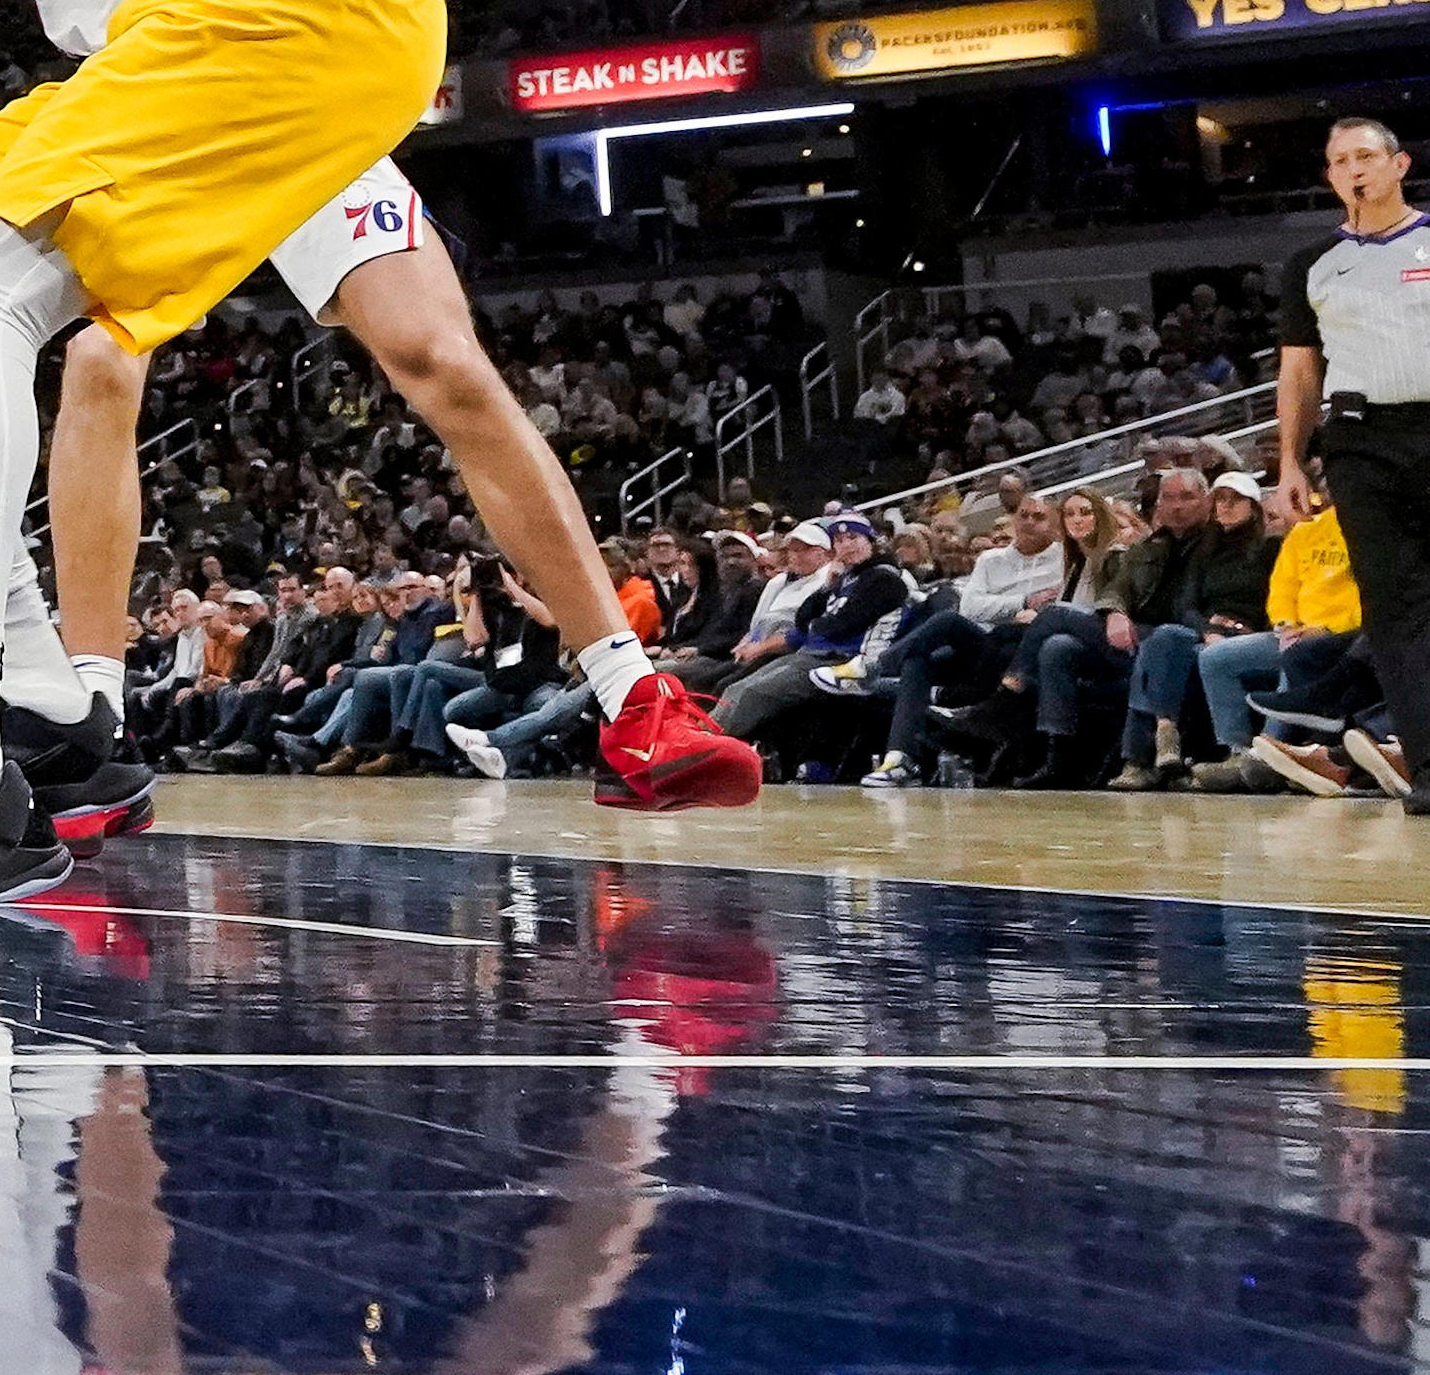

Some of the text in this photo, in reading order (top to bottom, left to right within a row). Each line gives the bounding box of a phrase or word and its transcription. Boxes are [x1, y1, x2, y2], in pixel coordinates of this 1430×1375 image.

[517, 62, 614, 98] STEAK
[641, 48, 747, 85] SHAKE
[344, 199, 403, 242] 76
